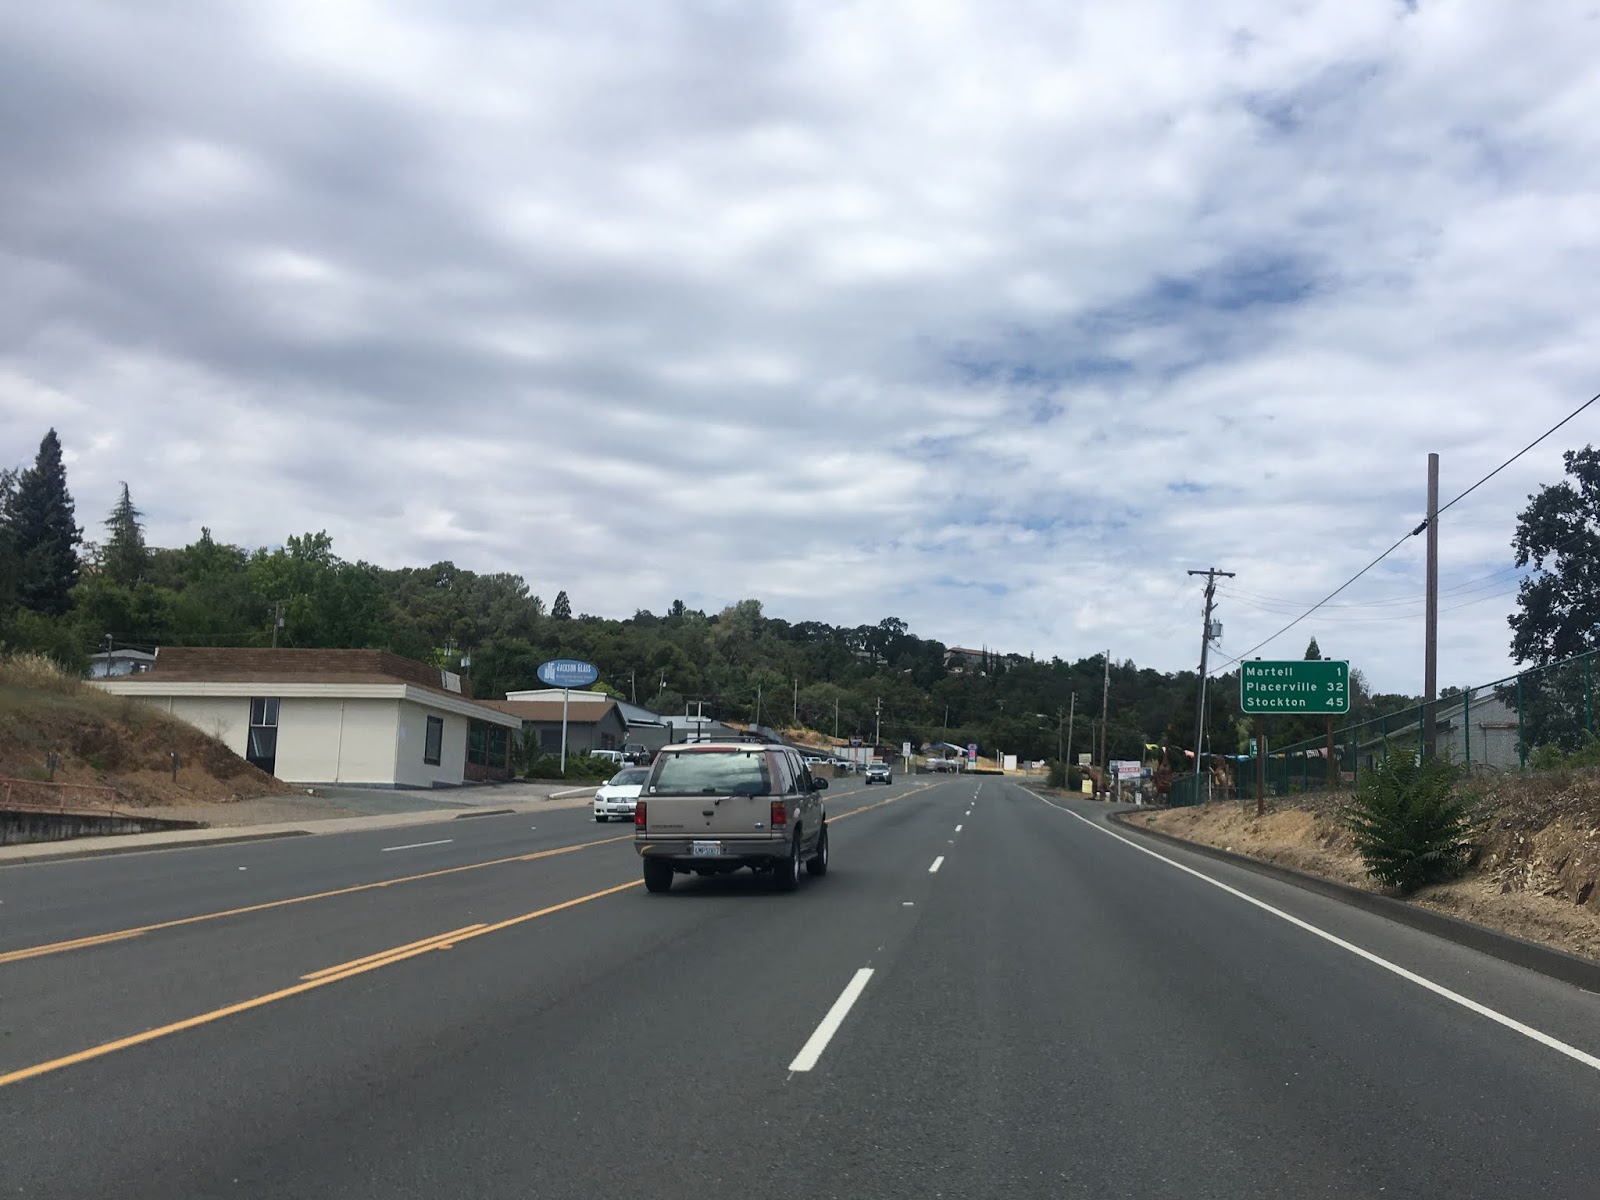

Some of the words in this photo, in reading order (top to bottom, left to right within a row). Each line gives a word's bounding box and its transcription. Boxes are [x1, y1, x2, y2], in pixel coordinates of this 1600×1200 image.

[556, 663, 577, 673] JACKSON
[577, 663, 592, 673] GLASS
[1246, 667, 1293, 676] Martell
[1336, 667, 1342, 676] 1
[1246, 681, 1318, 692] Placerville
[1326, 682, 1344, 692] 32
[1247, 697, 1306, 707] Stockton
[1325, 697, 1344, 707] 45
